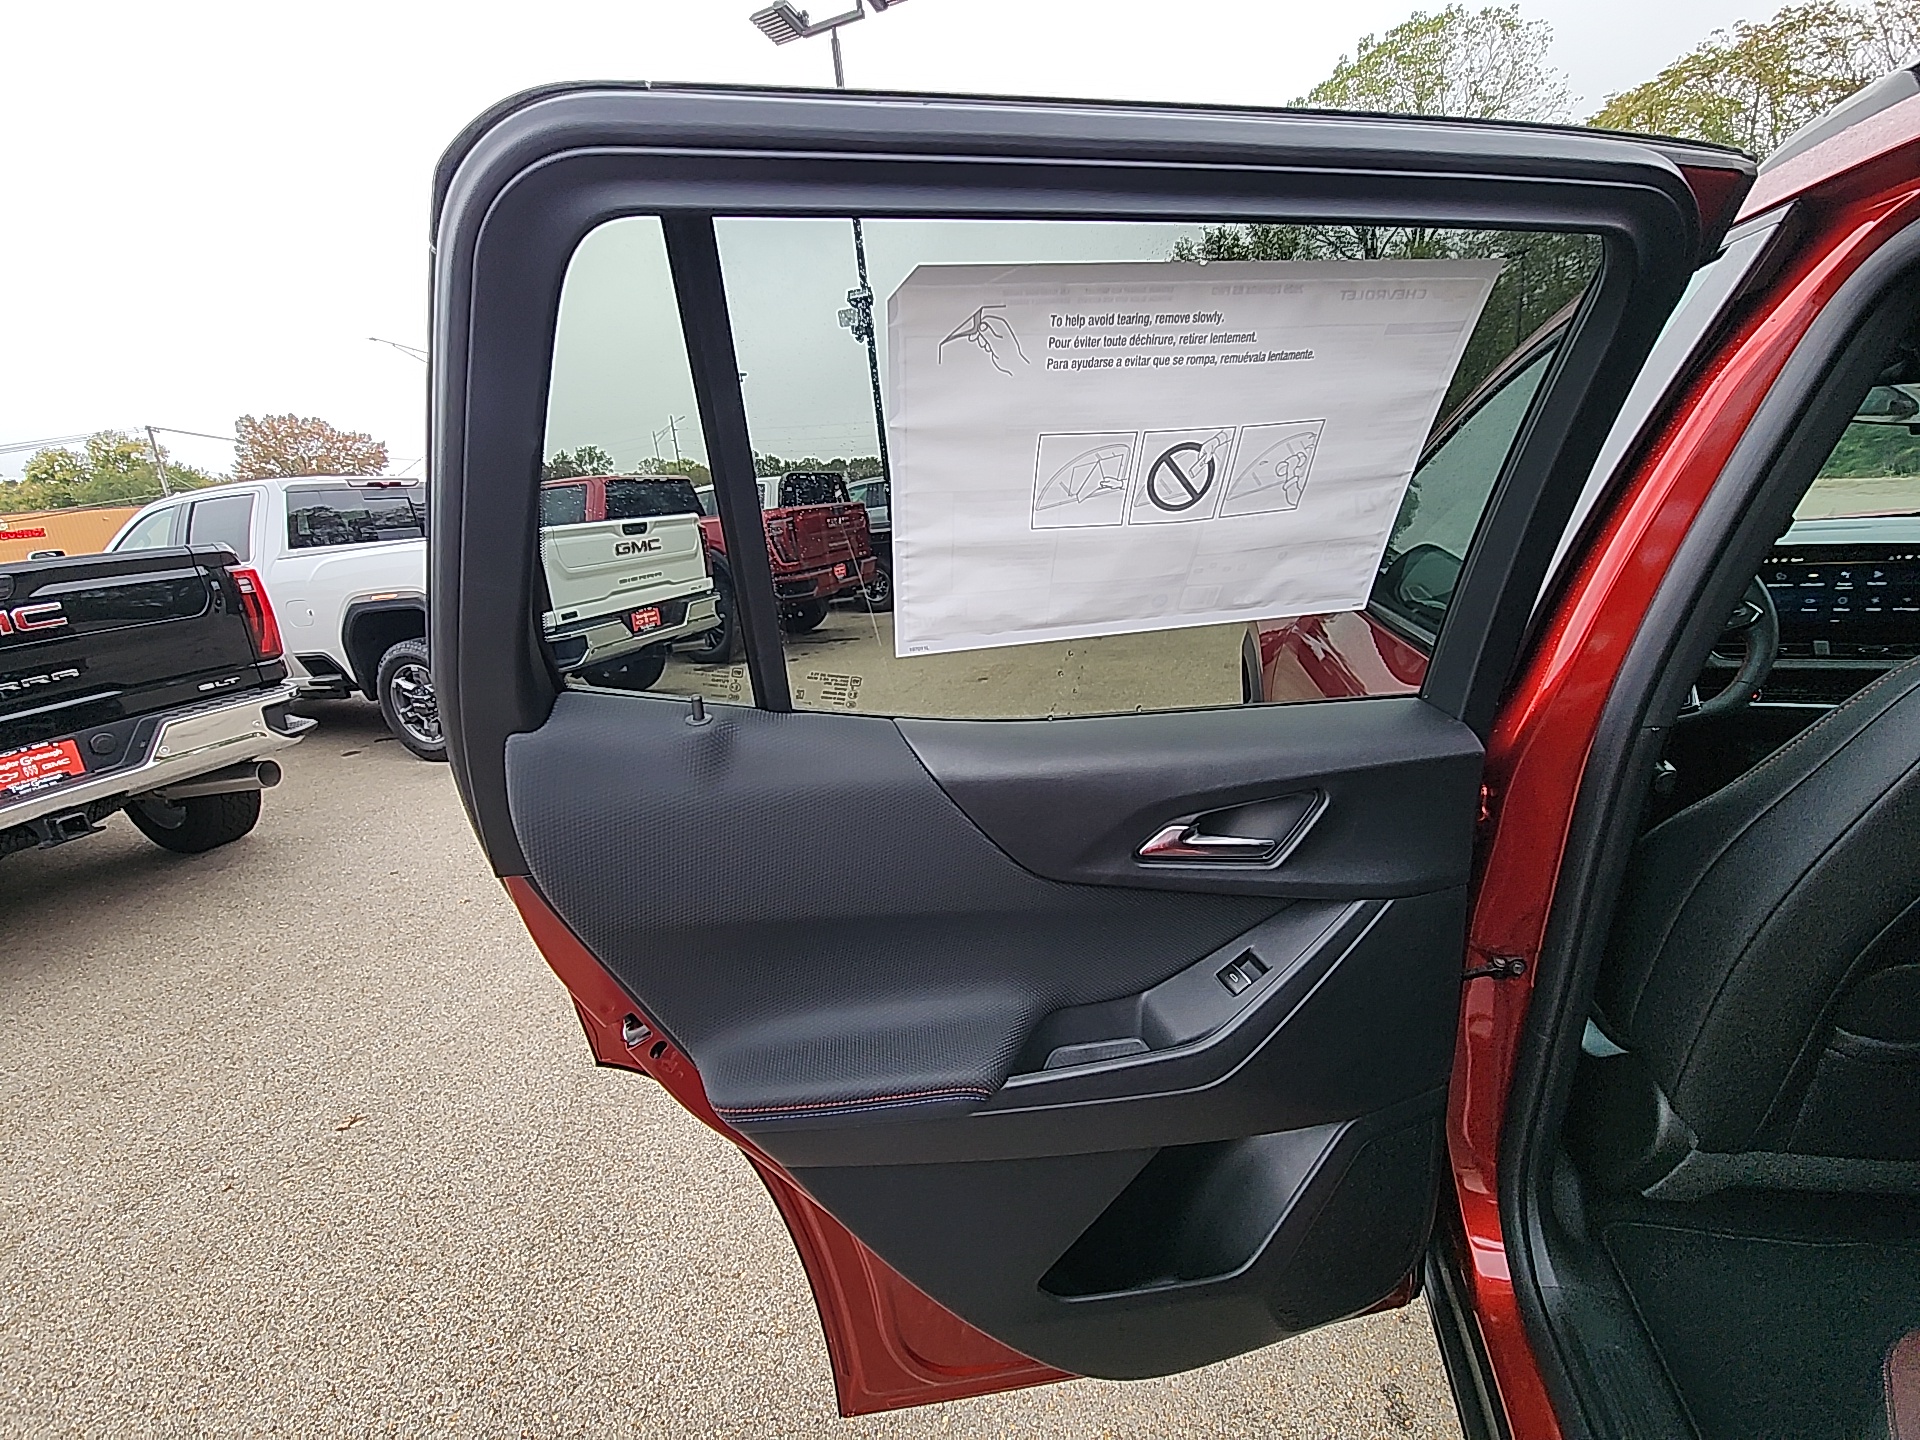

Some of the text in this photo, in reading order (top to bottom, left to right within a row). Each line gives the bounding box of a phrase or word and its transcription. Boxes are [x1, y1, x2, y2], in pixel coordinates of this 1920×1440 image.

[1050, 311, 1225, 328] To help avoid tearing, remove slowly.
[1048, 331, 1257, 348] Pour éviter toute déchirure, retirer lentement.
[1046, 349, 1315, 371] Para ayudarse a evitar que se rompa, remuévala lentamente.
[615, 538, 662, 556] GMC
[619, 571, 663, 585] SIERRA
[0, 601, 69, 636] C
[198, 676, 241, 691] SLT
[41, 757, 72, 771] GMC
